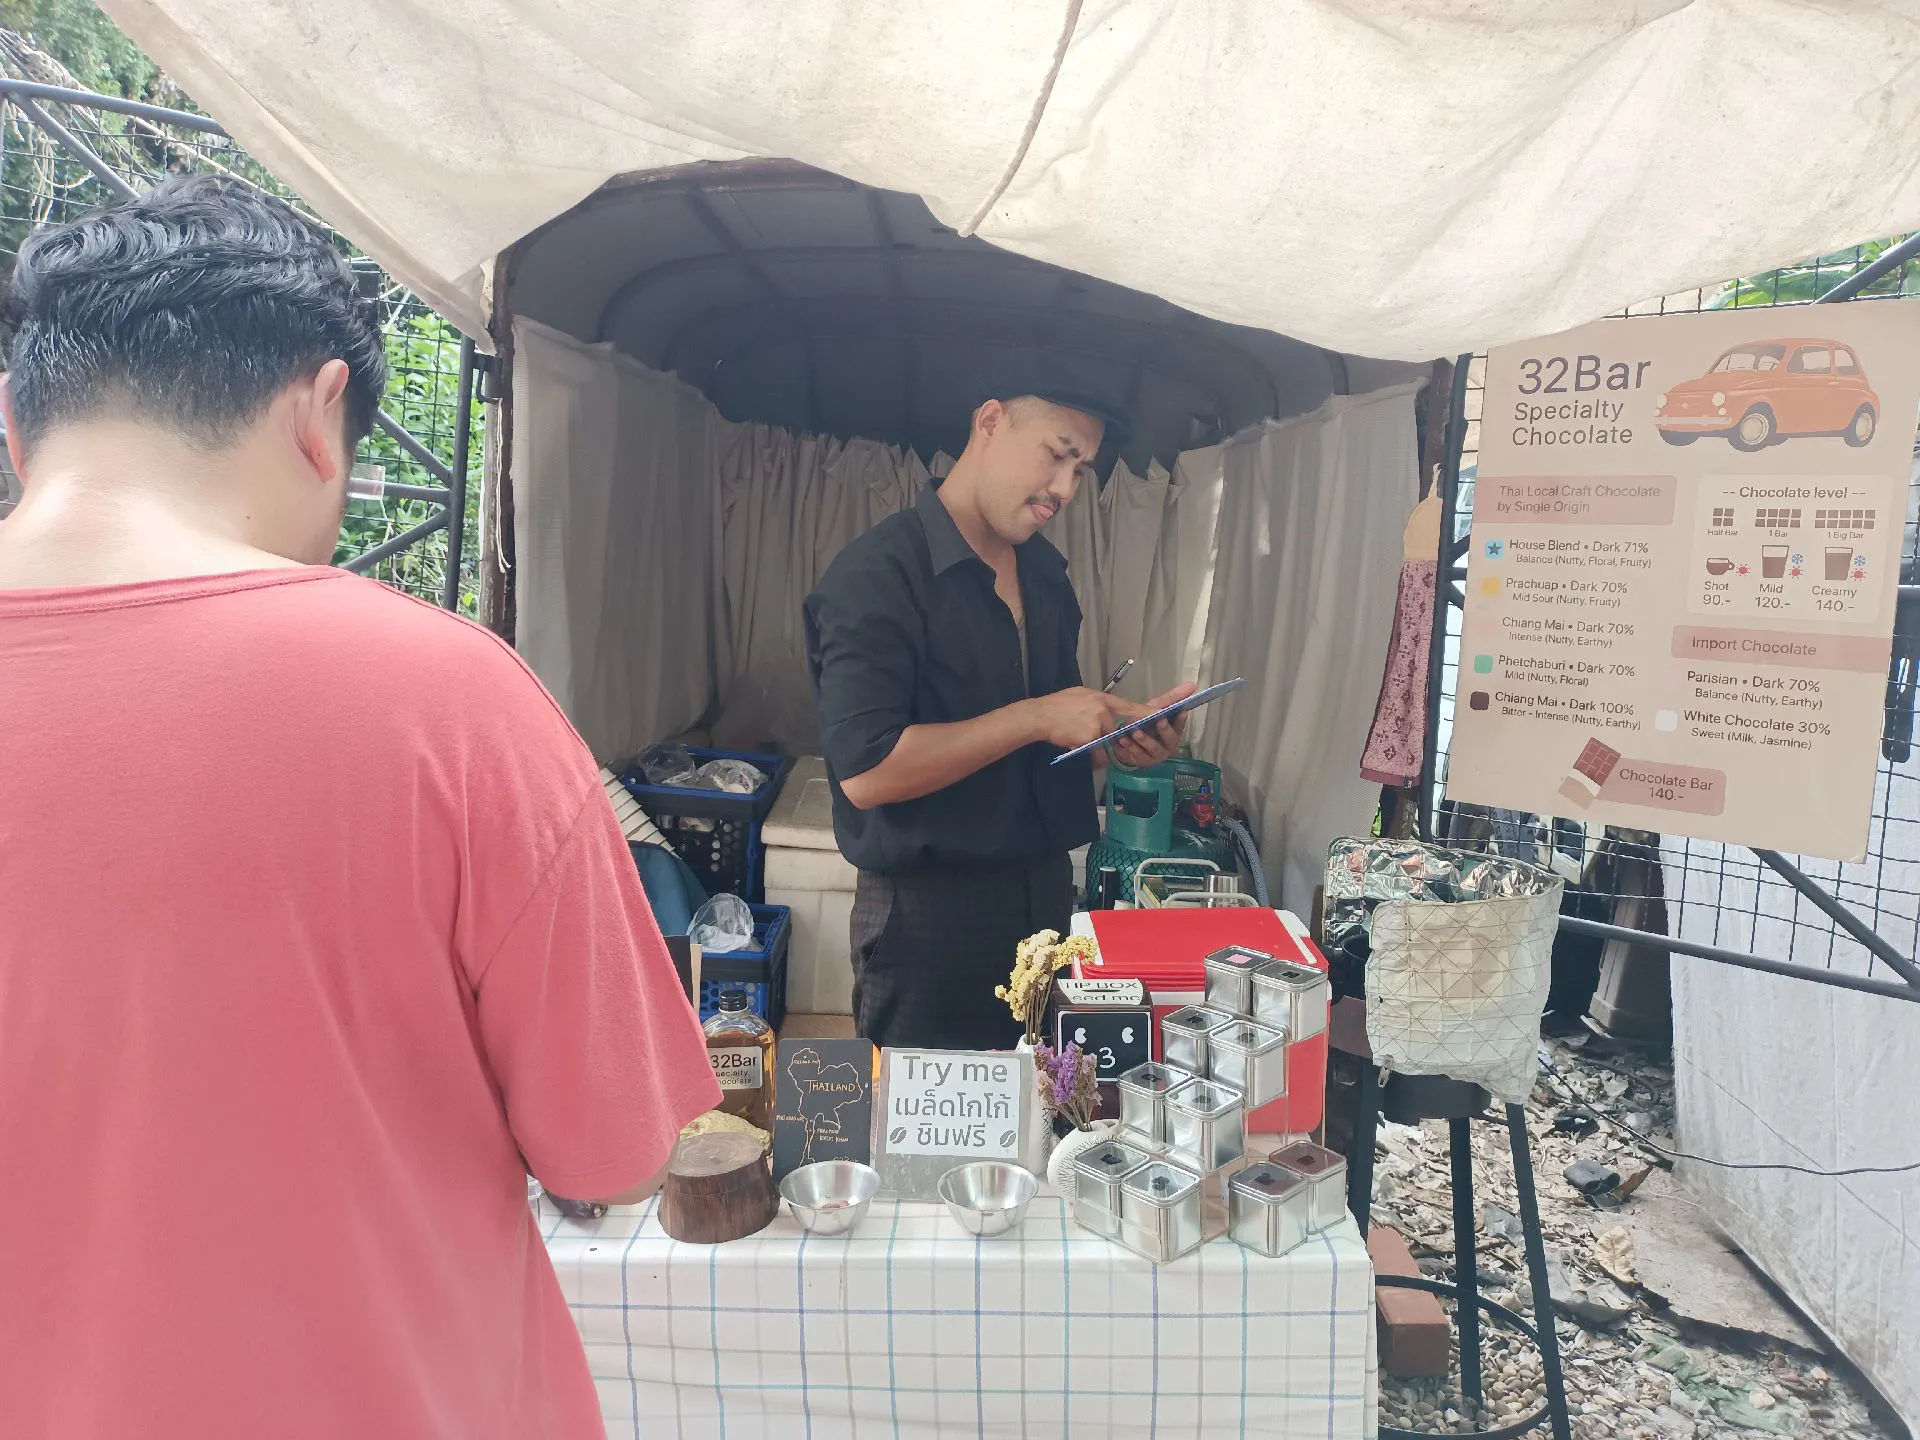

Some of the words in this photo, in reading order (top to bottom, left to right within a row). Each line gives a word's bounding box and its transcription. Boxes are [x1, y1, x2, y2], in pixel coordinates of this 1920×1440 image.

[1518, 354, 1652, 394] 32Bar
[1514, 398, 1624, 424] Specialty
[1512, 424, 1633, 446] Chocolate
[1500, 485, 1524, 497] Thai
[1527, 485, 1558, 497] Local
[1561, 485, 1592, 497] Craft
[1595, 485, 1662, 497] Chocolate
[1739, 486, 1810, 498] Chocolate
[1814, 486, 1847, 499] level
[1497, 501, 1511, 514] by
[1514, 500, 1550, 514] Single
[1554, 501, 1590, 515] Origin
[1834, 531, 1847, 540] Big
[1509, 540, 1545, 550] House
[1548, 540, 1580, 551] Blend
[1592, 541, 1620, 552] Dark
[1624, 542, 1649, 553] 71%
[1516, 554, 1552, 564] Balance
[1555, 555, 1585, 566] (Nutty,
[1588, 556, 1618, 567] Floral,
[1620, 557, 1652, 569] Fruity)
[1506, 578, 1558, 591] Prachuap
[1570, 580, 1598, 592] Dark
[1601, 582, 1628, 594] 70%
[1704, 580, 1729, 591] Shot
[1760, 584, 1784, 593] Mild
[1812, 585, 1857, 598] Creamy
[1512, 593, 1530, 602] Mid
[1532, 594, 1554, 603] Sour
[1556, 595, 1587, 606] (Nutty,
[1589, 596, 1621, 608] Fruity)
[1703, 594, 1731, 606] 90.-
[1755, 597, 1790, 609] 120.-
[1817, 600, 1854, 612] 140.-
[1502, 616, 1542, 631] Chiang
[1544, 619, 1565, 630] Mai
[1577, 621, 1604, 634] Dark
[1607, 623, 1634, 635] 70%
[1509, 632, 1542, 642] Intense
[1545, 634, 1574, 647] (Nutty,
[1577, 637, 1613, 649] Earthy)
[1692, 636, 1737, 651] Import
[1741, 639, 1817, 656] Chocolate
[1498, 655, 1565, 671] Phetchaburi
[1577, 662, 1605, 674] Dark
[1608, 664, 1635, 677] 70%
[1505, 670, 1525, 680] Mild
[1527, 672, 1558, 685] (Nutty,
[1559, 675, 1589, 687] Floral)
[1687, 671, 1737, 686] Parisian
[1752, 676, 1785, 689] Dark
[1789, 678, 1820, 693] 70%
[1495, 691, 1534, 707] Chiang
[1537, 695, 1558, 707] Mai
[1569, 698, 1596, 711] Dark
[1600, 702, 1634, 716] 100%
[1695, 688, 1739, 701] Balance
[1741, 692, 1778, 707] (Nutty,
[1782, 695, 1823, 711] Earthy)
[1502, 706, 1526, 717] Bitter
[1535, 710, 1569, 722] Intense
[1571, 714, 1603, 727] (Nutty,
[1605, 718, 1641, 730] Earthy)
[1684, 710, 1721, 724] White
[1724, 714, 1794, 731] Chocolate
[1797, 721, 1831, 736] 30%
[1691, 727, 1724, 740] Sweet
[1727, 731, 1757, 744] (Milk,
[1760, 735, 1812, 750] Jasmine)
[1619, 768, 1687, 787] Chocolate
[1690, 777, 1714, 791] Bar
[1649, 786, 1684, 801] 140.-
[710, 1054, 757, 1068] 32Bar
[902, 1056, 952, 1086] Try
[962, 1063, 1008, 1082] me
[803, 1080, 856, 1094] THAILAND
[895, 1089, 1011, 1118] เมล็ดโกโก้
[917, 1122, 986, 1147] ชิมฟรี
